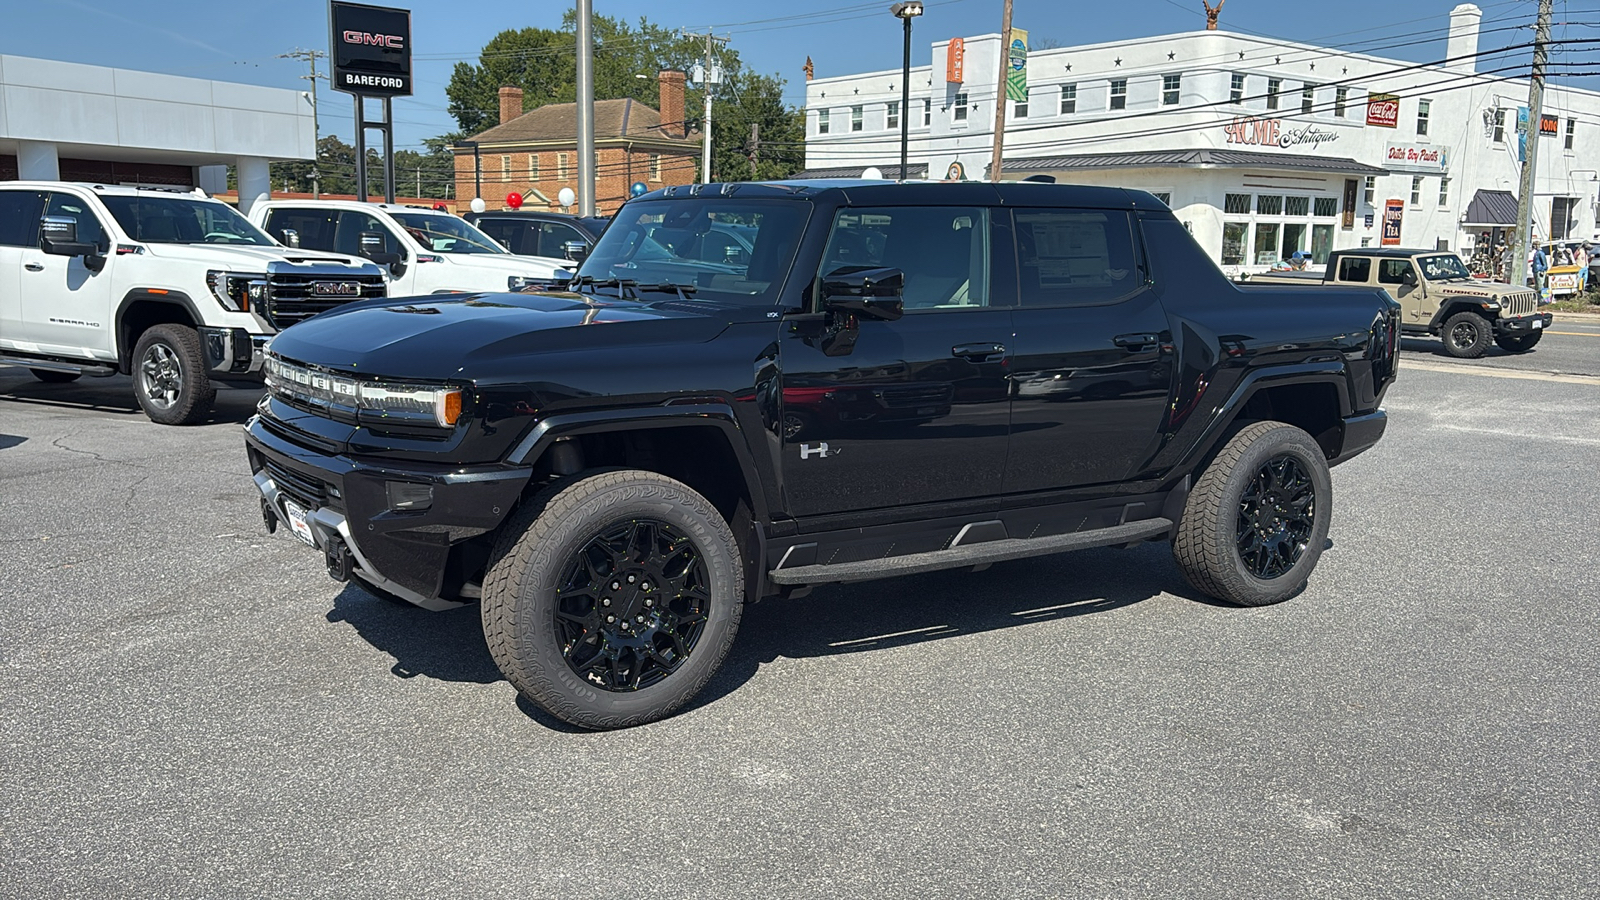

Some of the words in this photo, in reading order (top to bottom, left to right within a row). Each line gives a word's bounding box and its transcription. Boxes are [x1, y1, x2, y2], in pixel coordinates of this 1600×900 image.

[343, 30, 404, 49] GMC
[953, 41, 962, 80] ACME
[346, 74, 403, 88] BAREFORD
[1224, 115, 1281, 147] ACME
[1388, 147, 1406, 160] Dutch
[1407, 148, 1419, 163] Boy
[1419, 149, 1439, 162] Paints
[1386, 225, 1399, 237] TEA
[316, 282, 358, 294] GMC
[49, 317, 84, 326] SIERRA
[680, 513, 729, 602] WRANGLER
